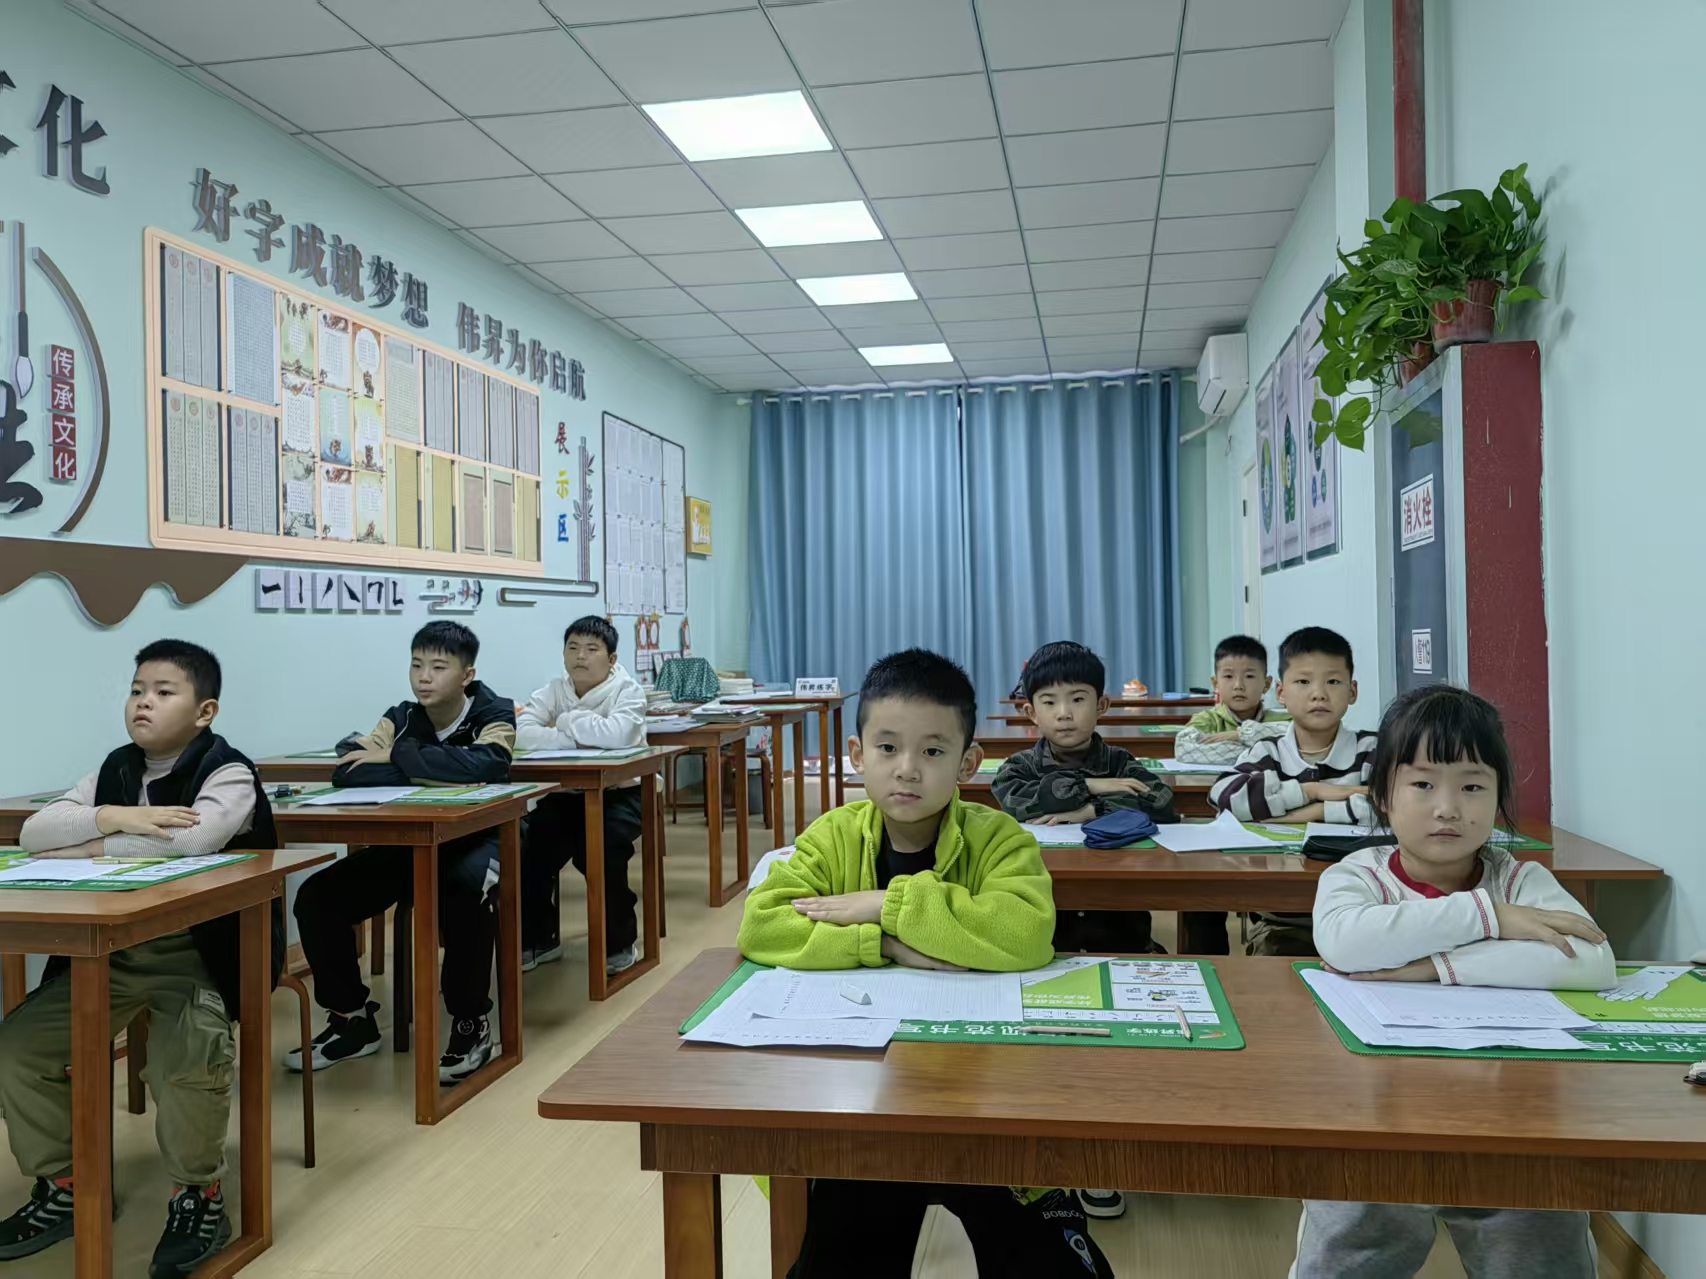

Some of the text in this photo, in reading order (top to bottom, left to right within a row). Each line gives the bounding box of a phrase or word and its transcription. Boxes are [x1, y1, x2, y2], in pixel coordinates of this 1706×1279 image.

[52, 347, 76, 481] 传承文化
[554, 421, 570, 542] 展示区
[1404, 486, 1432, 535] 消火栓
